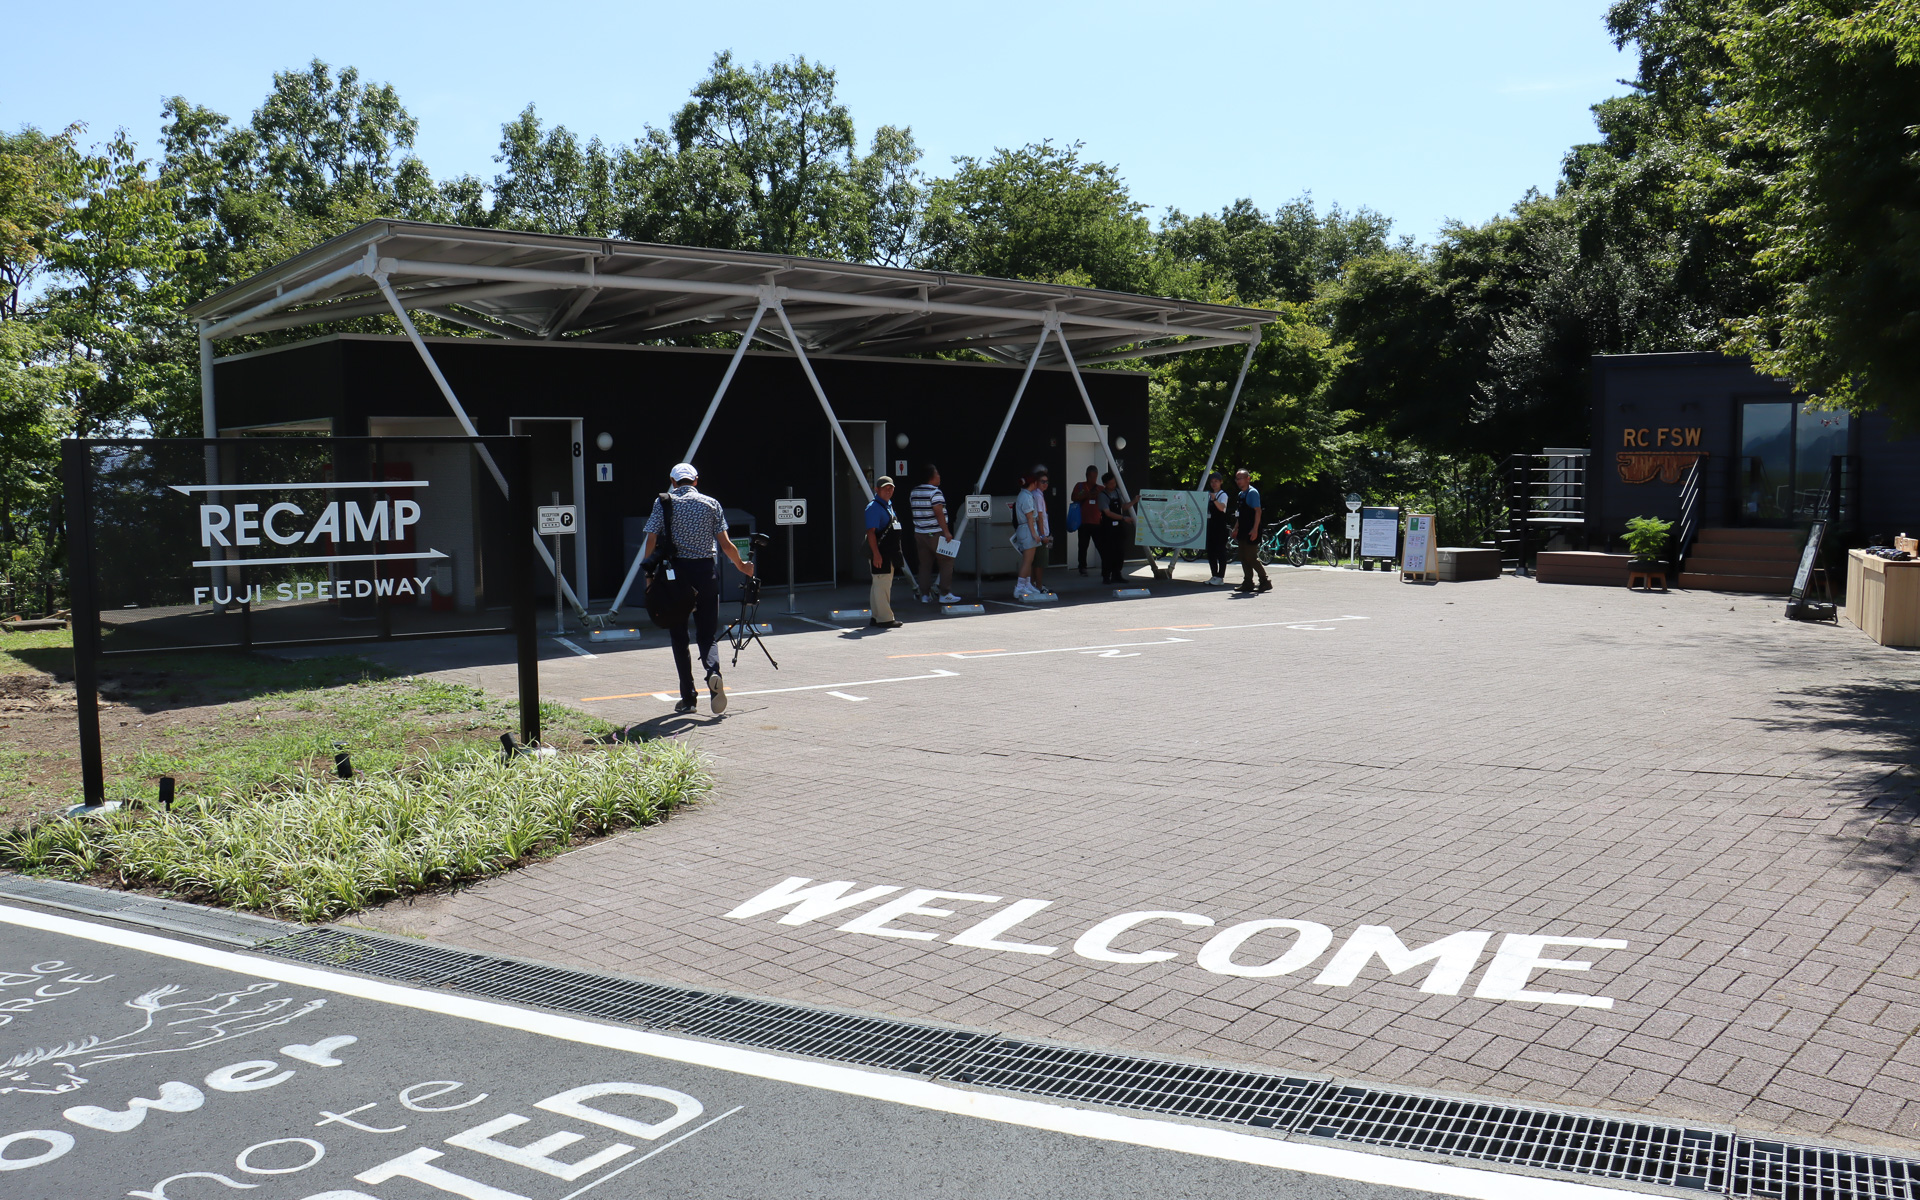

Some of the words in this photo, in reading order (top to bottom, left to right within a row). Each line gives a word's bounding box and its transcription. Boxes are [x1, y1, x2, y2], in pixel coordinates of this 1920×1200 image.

[573, 441, 581, 458] 8
[1624, 429, 1649, 446] RC
[1658, 428, 1701, 446] FSW
[200, 500, 420, 547] RECAMP
[194, 585, 261, 605] FUJI
[276, 577, 432, 602] SPEEDWAY
[724, 876, 1629, 1009] WELCOME
[300, 1081, 704, 1200] TED
